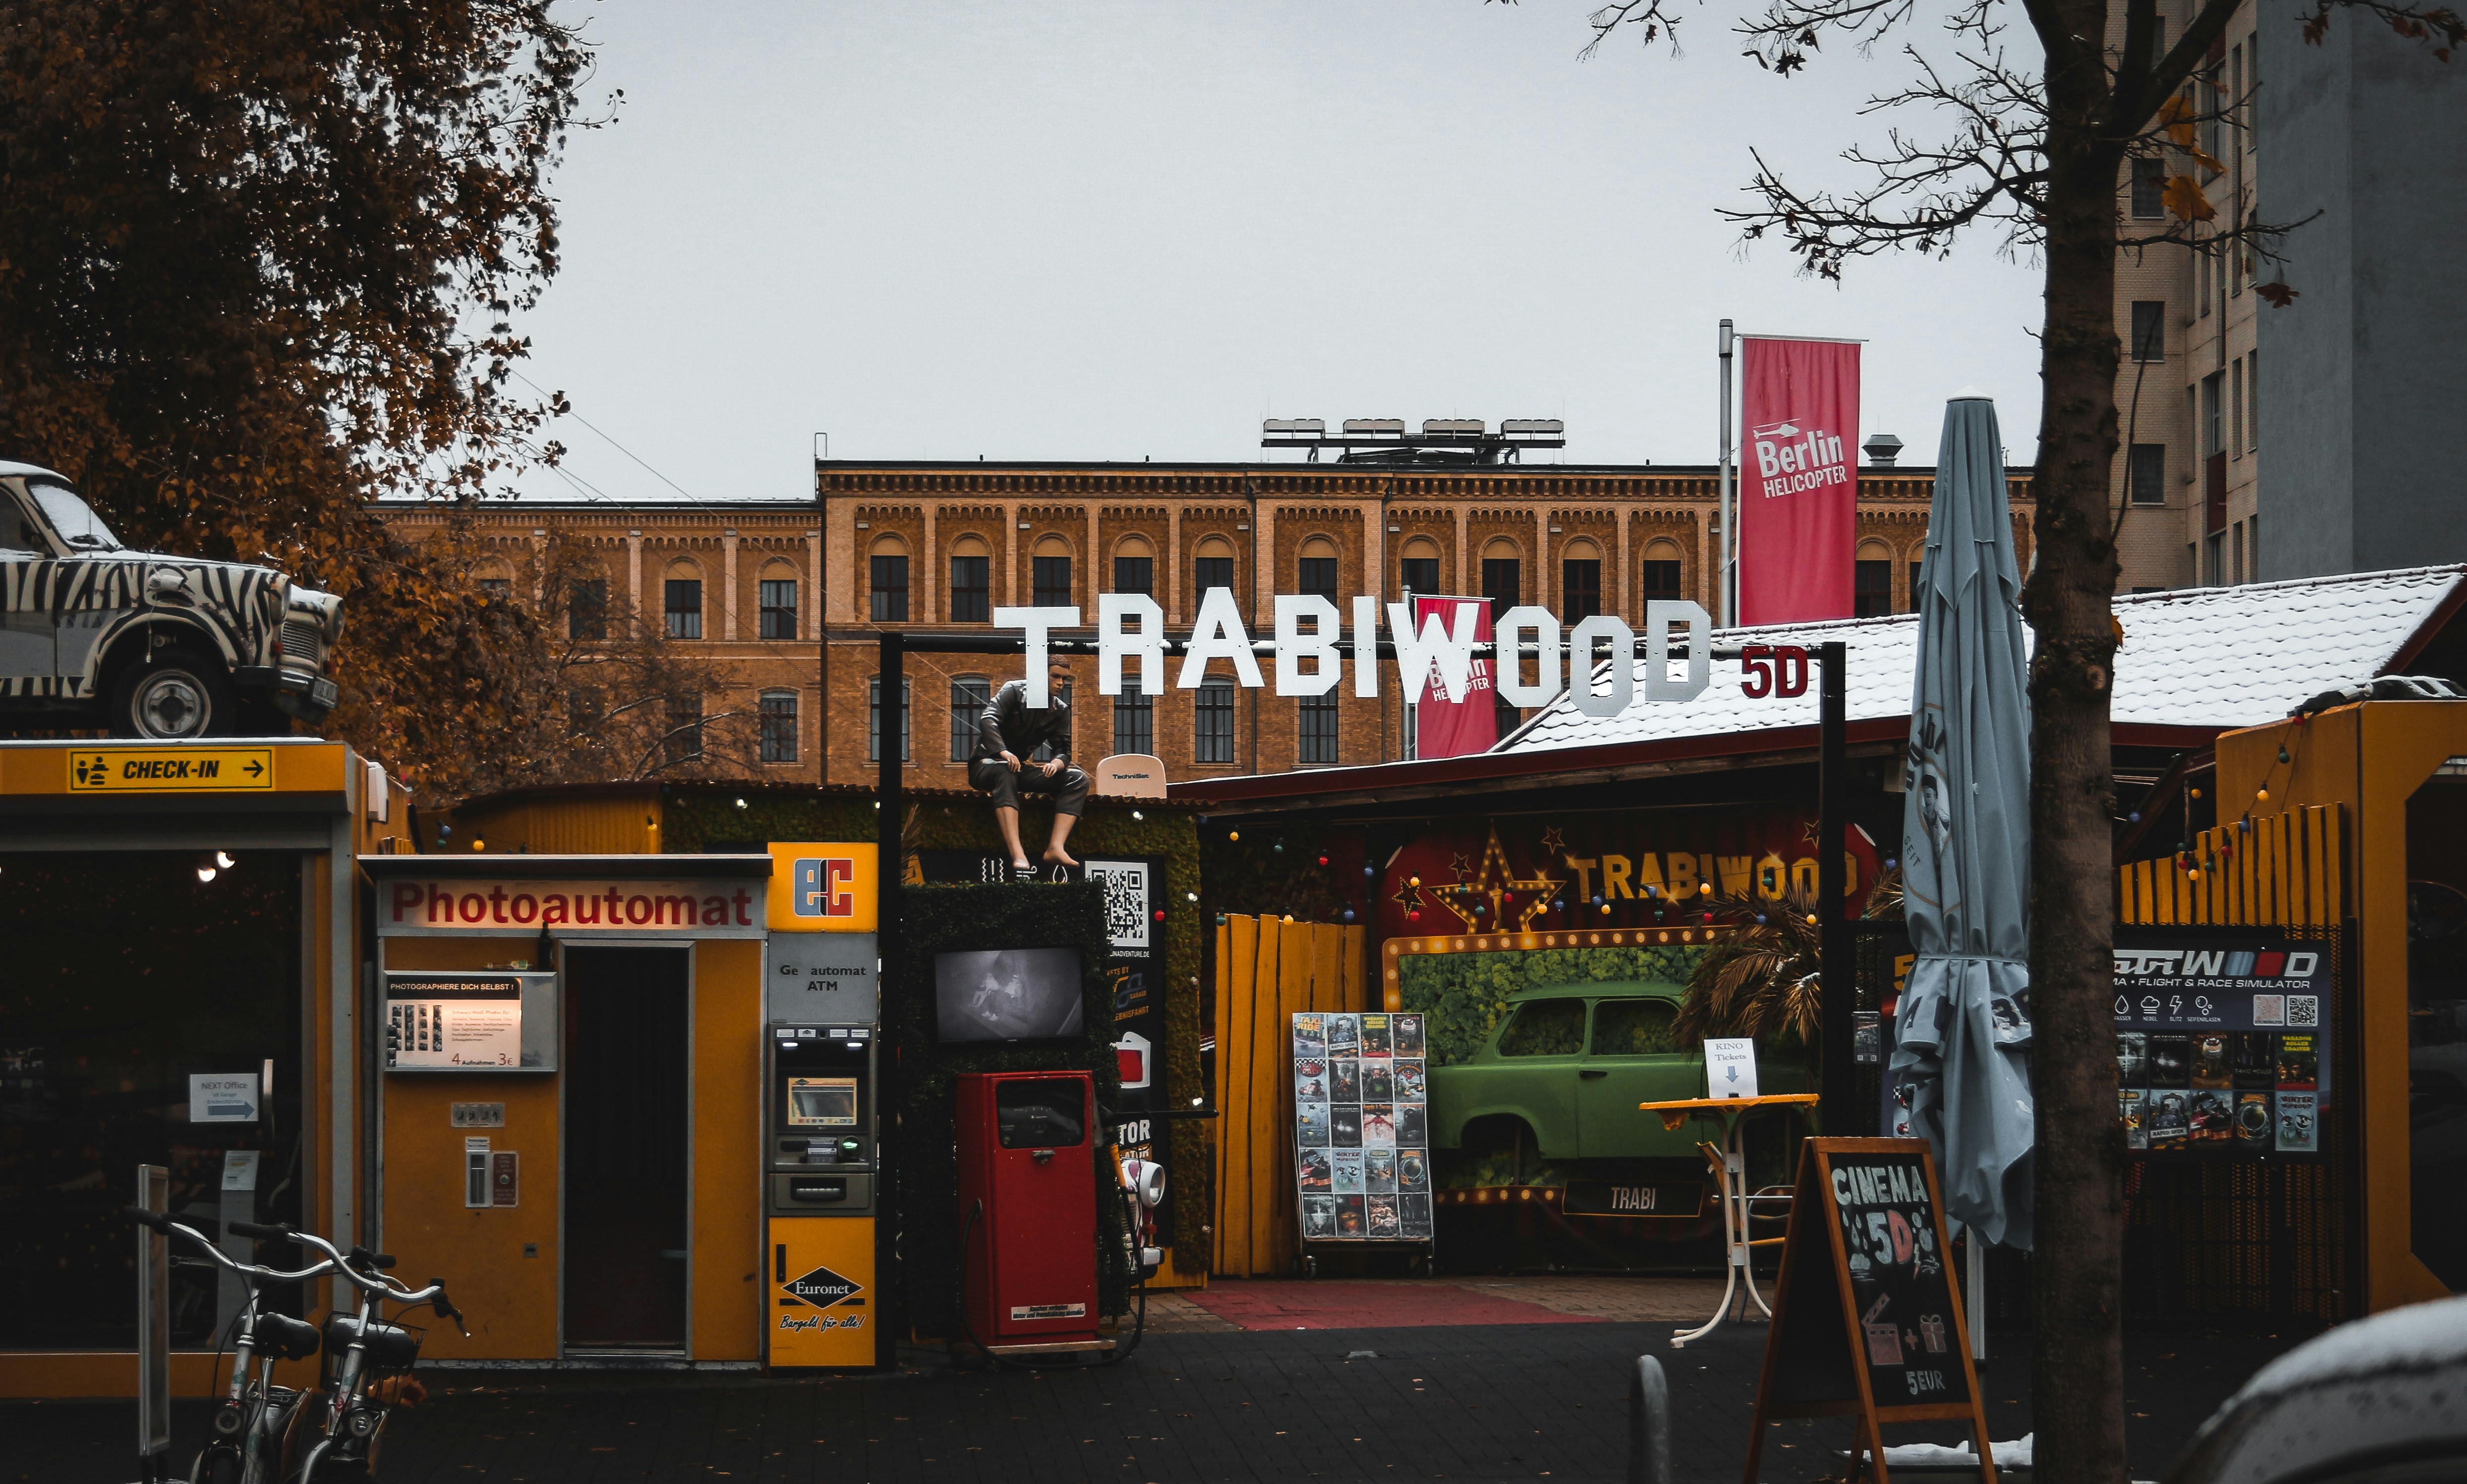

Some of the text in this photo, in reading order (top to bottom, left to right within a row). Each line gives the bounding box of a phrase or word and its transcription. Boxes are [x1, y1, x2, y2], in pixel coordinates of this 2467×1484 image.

[1755, 430, 1844, 478] Berlin
[1763, 465, 1848, 498] HELICOPTER
[994, 587, 1808, 717] TRABIWOOD 5D
[1433, 678, 1490, 702] HEPTER
[123, 760, 220, 779] CHECK-IN
[392, 882, 752, 926] Photoautomat
[807, 981, 838, 991] ATM
[452, 1053, 461, 1065] 4
[1117, 1119, 1150, 1145] TOR
[1832, 1165, 1929, 1205] CINEMA
[1611, 1187, 1655, 1210] TRABI
[1867, 1210, 1913, 1264] 5D
[796, 1282, 850, 1294] Euronet
[780, 1315, 866, 1333] Bargeld für alle!
